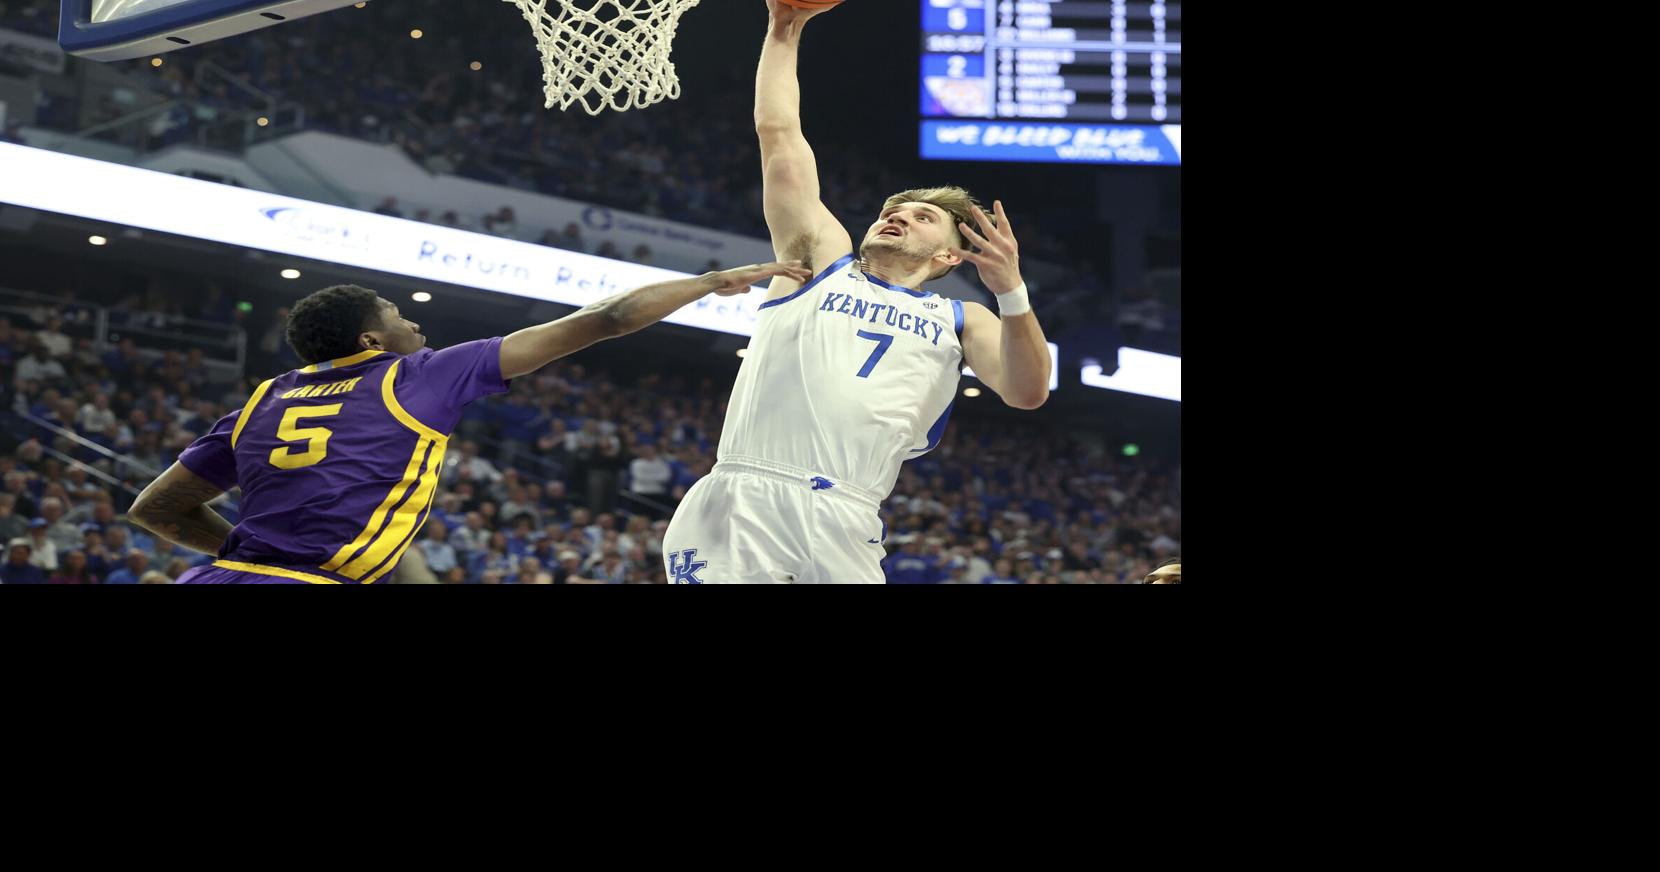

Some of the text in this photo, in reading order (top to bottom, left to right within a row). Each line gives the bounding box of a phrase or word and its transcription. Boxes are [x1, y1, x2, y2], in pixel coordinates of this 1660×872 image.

[417, 239, 530, 280] Return
[819, 292, 943, 346] KENTUCKY
[856, 329, 894, 378] 7
[269, 402, 343, 470] 5
